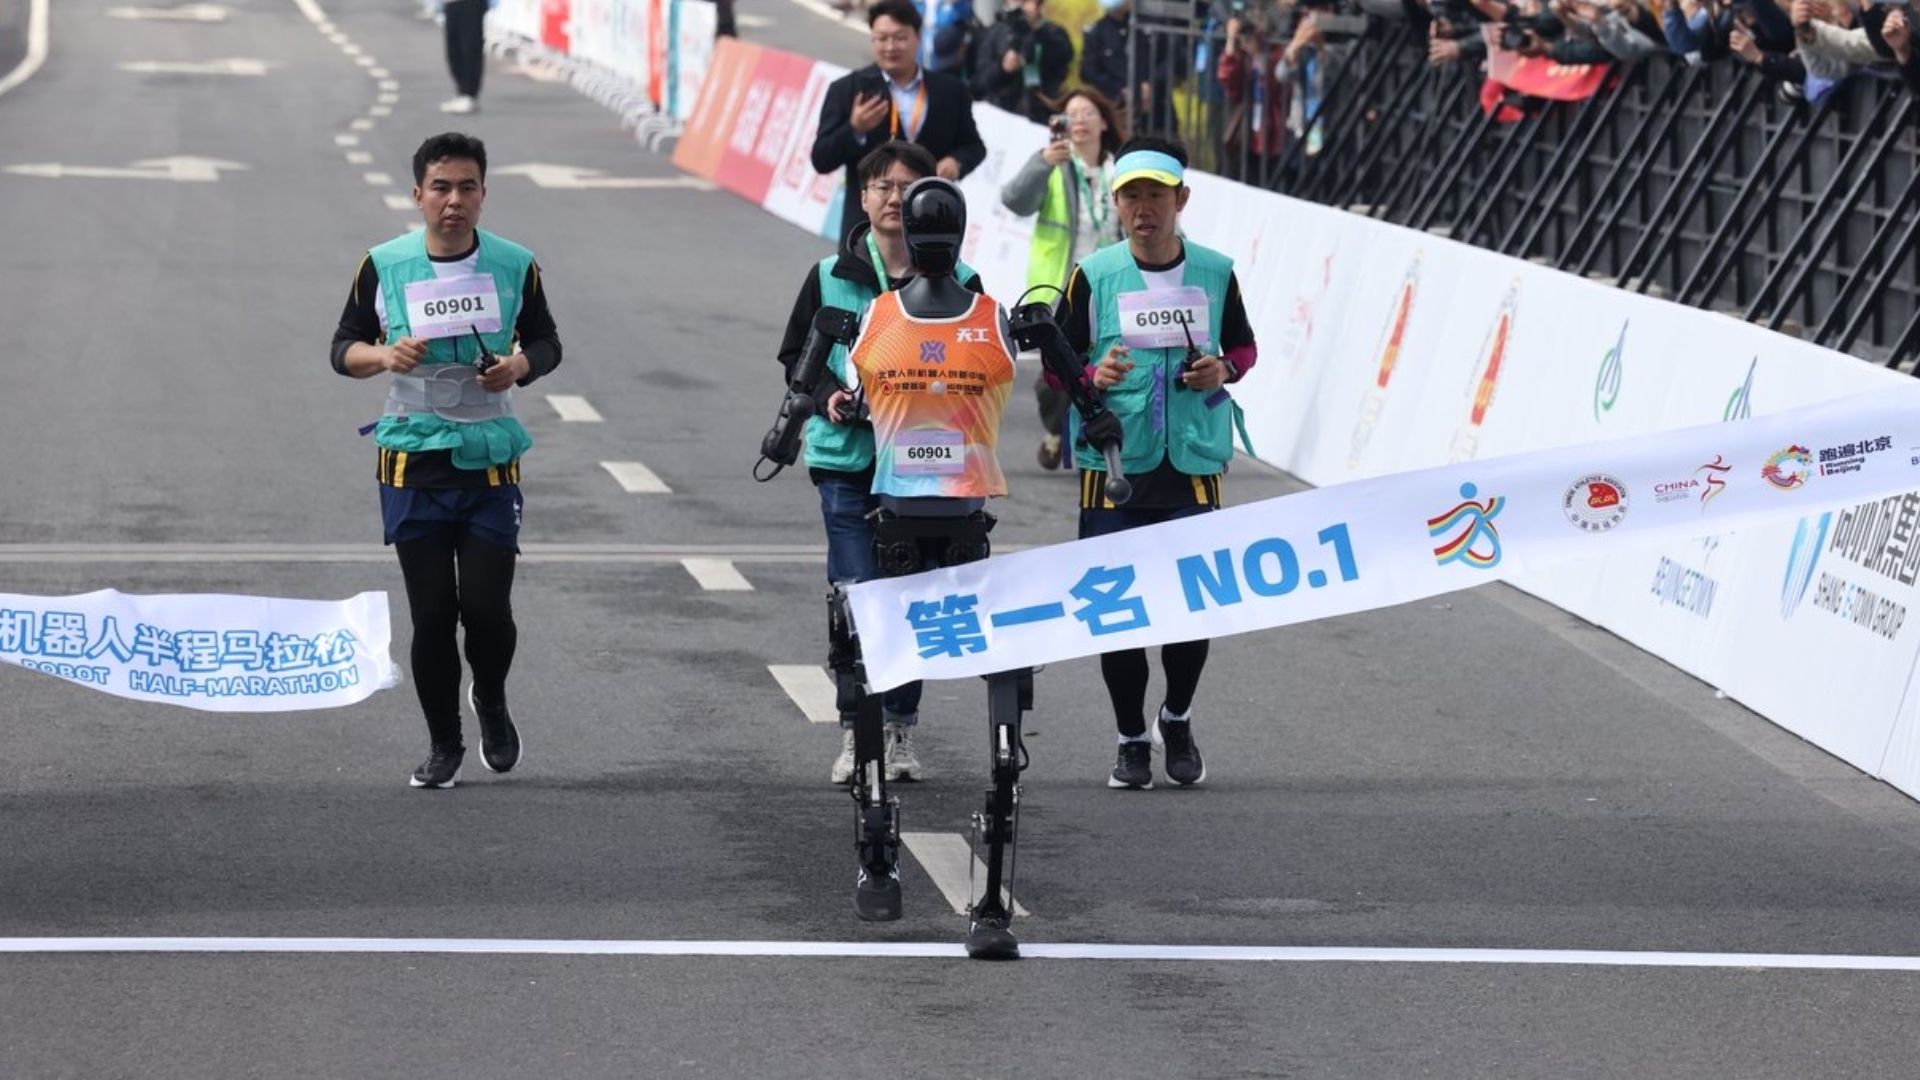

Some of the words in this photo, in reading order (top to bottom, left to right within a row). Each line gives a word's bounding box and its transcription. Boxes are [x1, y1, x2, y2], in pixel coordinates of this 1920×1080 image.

[423, 295, 485, 317] 60901
[1135, 308, 1196, 327] 60901
[956, 328, 990, 342] 天工
[907, 446, 953, 459] 60901
[1819, 435, 1892, 462] 跑遍北京
[1825, 456, 1865, 469] Running
[1826, 464, 1861, 475] Beijing
[1654, 479, 1700, 493] CHINA
[905, 564, 1151, 660] 第一名
[1175, 522, 1360, 613] NO.1
[0, 608, 357, 673] 机器人半程马拉松
[129, 664, 360, 697] HALF-MARATHON
